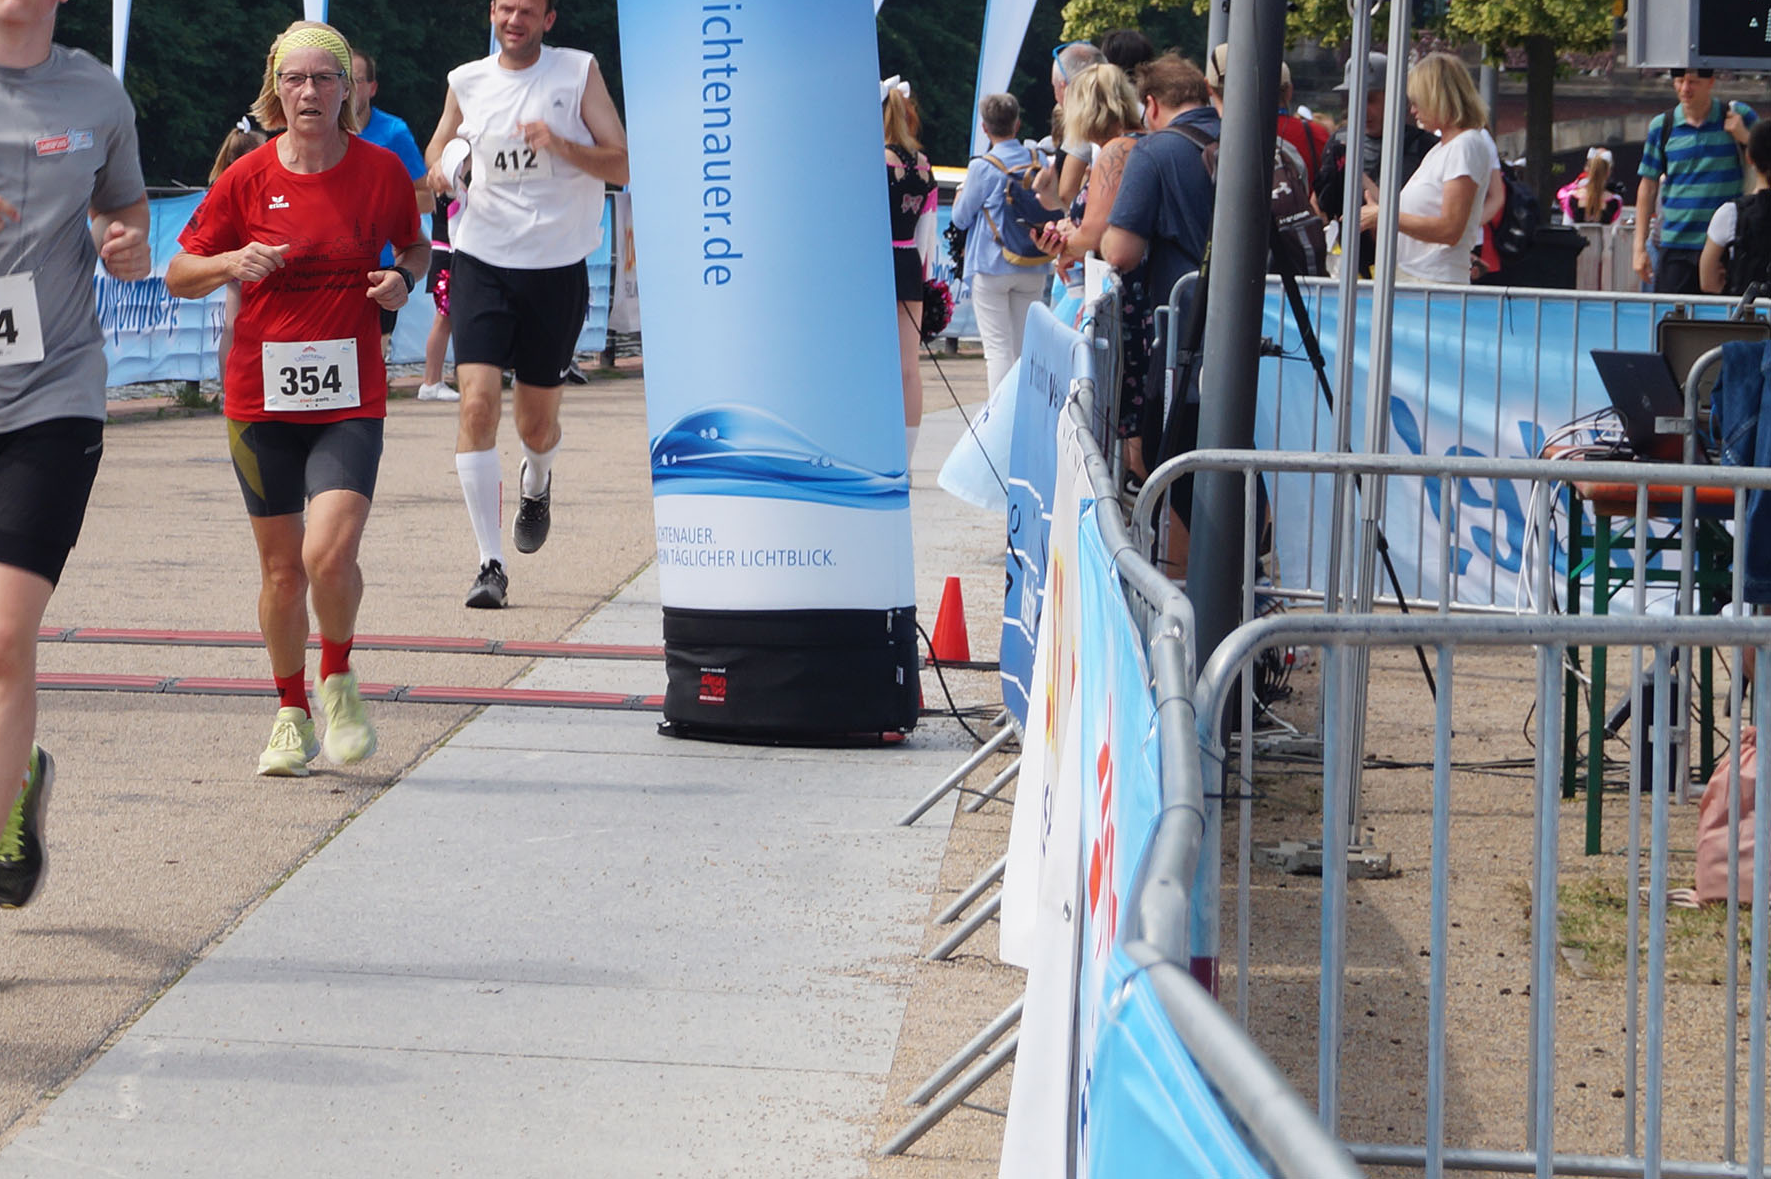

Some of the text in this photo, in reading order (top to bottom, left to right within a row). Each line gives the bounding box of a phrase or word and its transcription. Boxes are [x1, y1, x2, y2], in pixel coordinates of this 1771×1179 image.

[494, 147, 538, 171] 412
[279, 364, 342, 396] 354
[670, 546, 735, 567] TÄGLICHER
[741, 549, 837, 567] LICHTBLICK.
